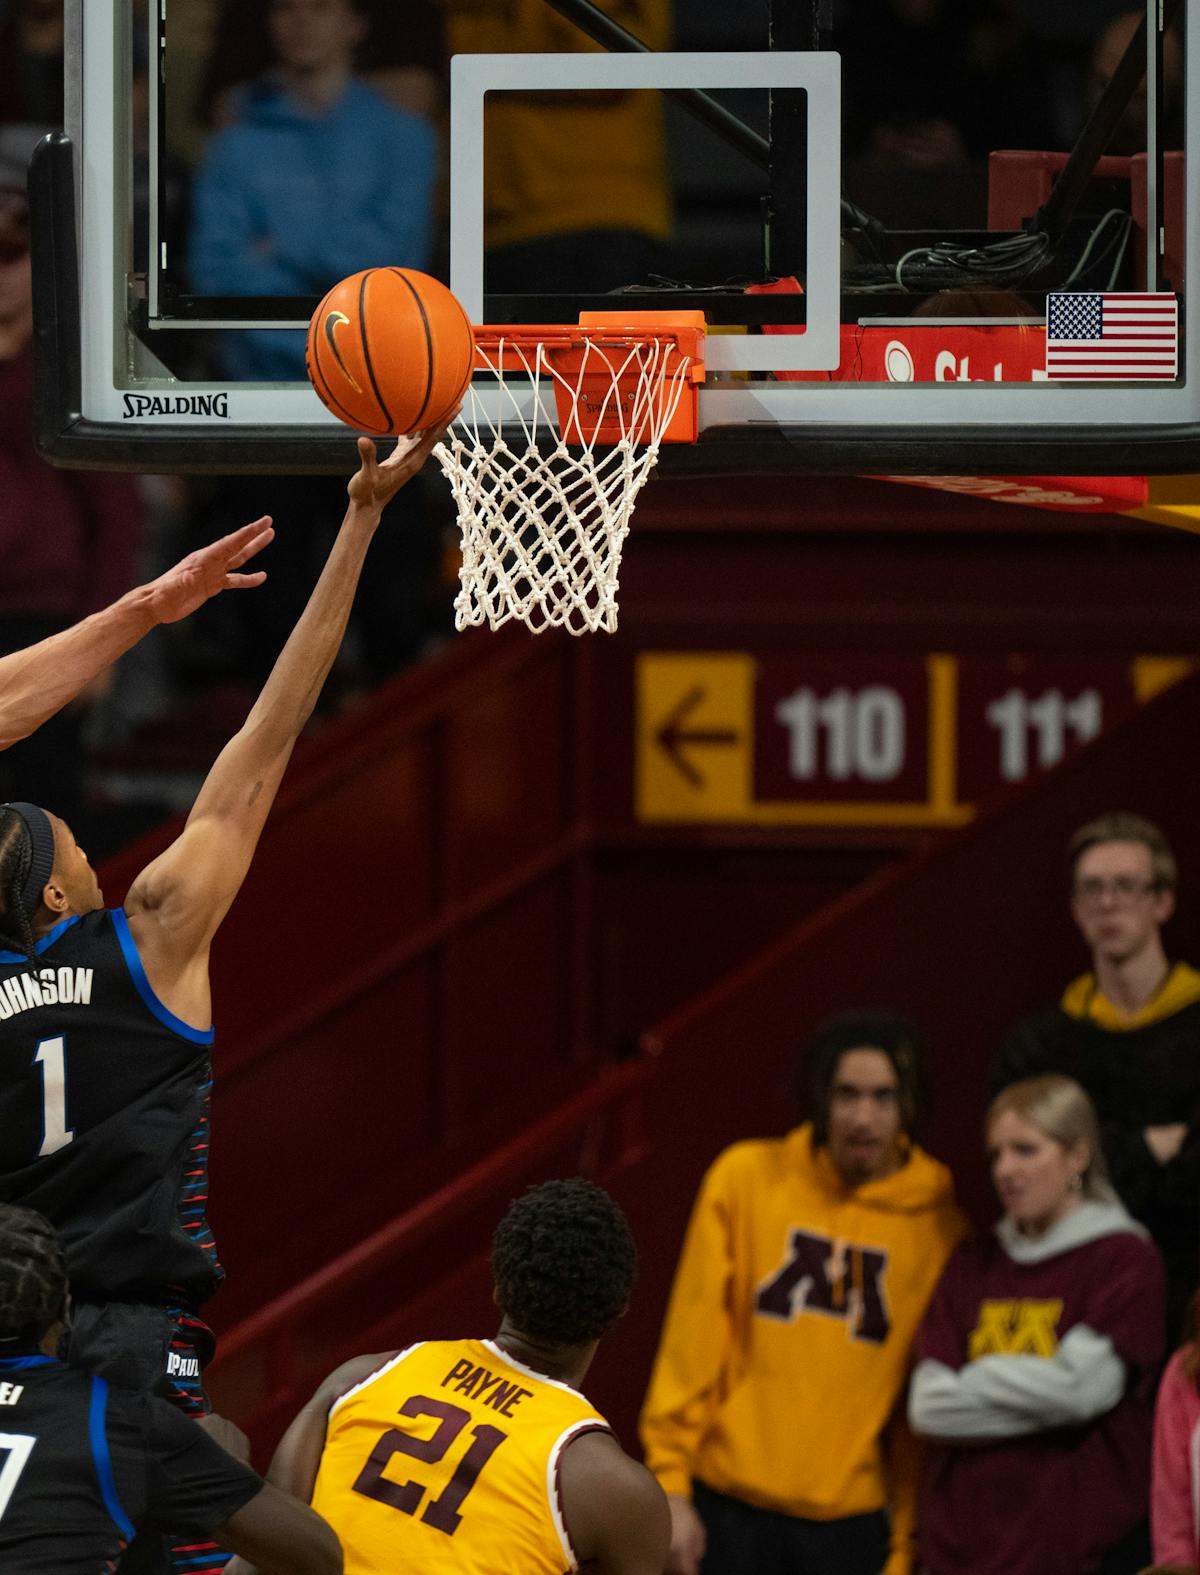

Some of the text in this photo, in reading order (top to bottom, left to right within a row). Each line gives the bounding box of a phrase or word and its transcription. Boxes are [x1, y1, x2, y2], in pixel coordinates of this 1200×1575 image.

[123, 393, 229, 419] SPALDING
[776, 687, 904, 780] 110
[33, 1034, 74, 1158] 1
[440, 1358, 534, 1418] PAYNE
[351, 1394, 508, 1537] 21
